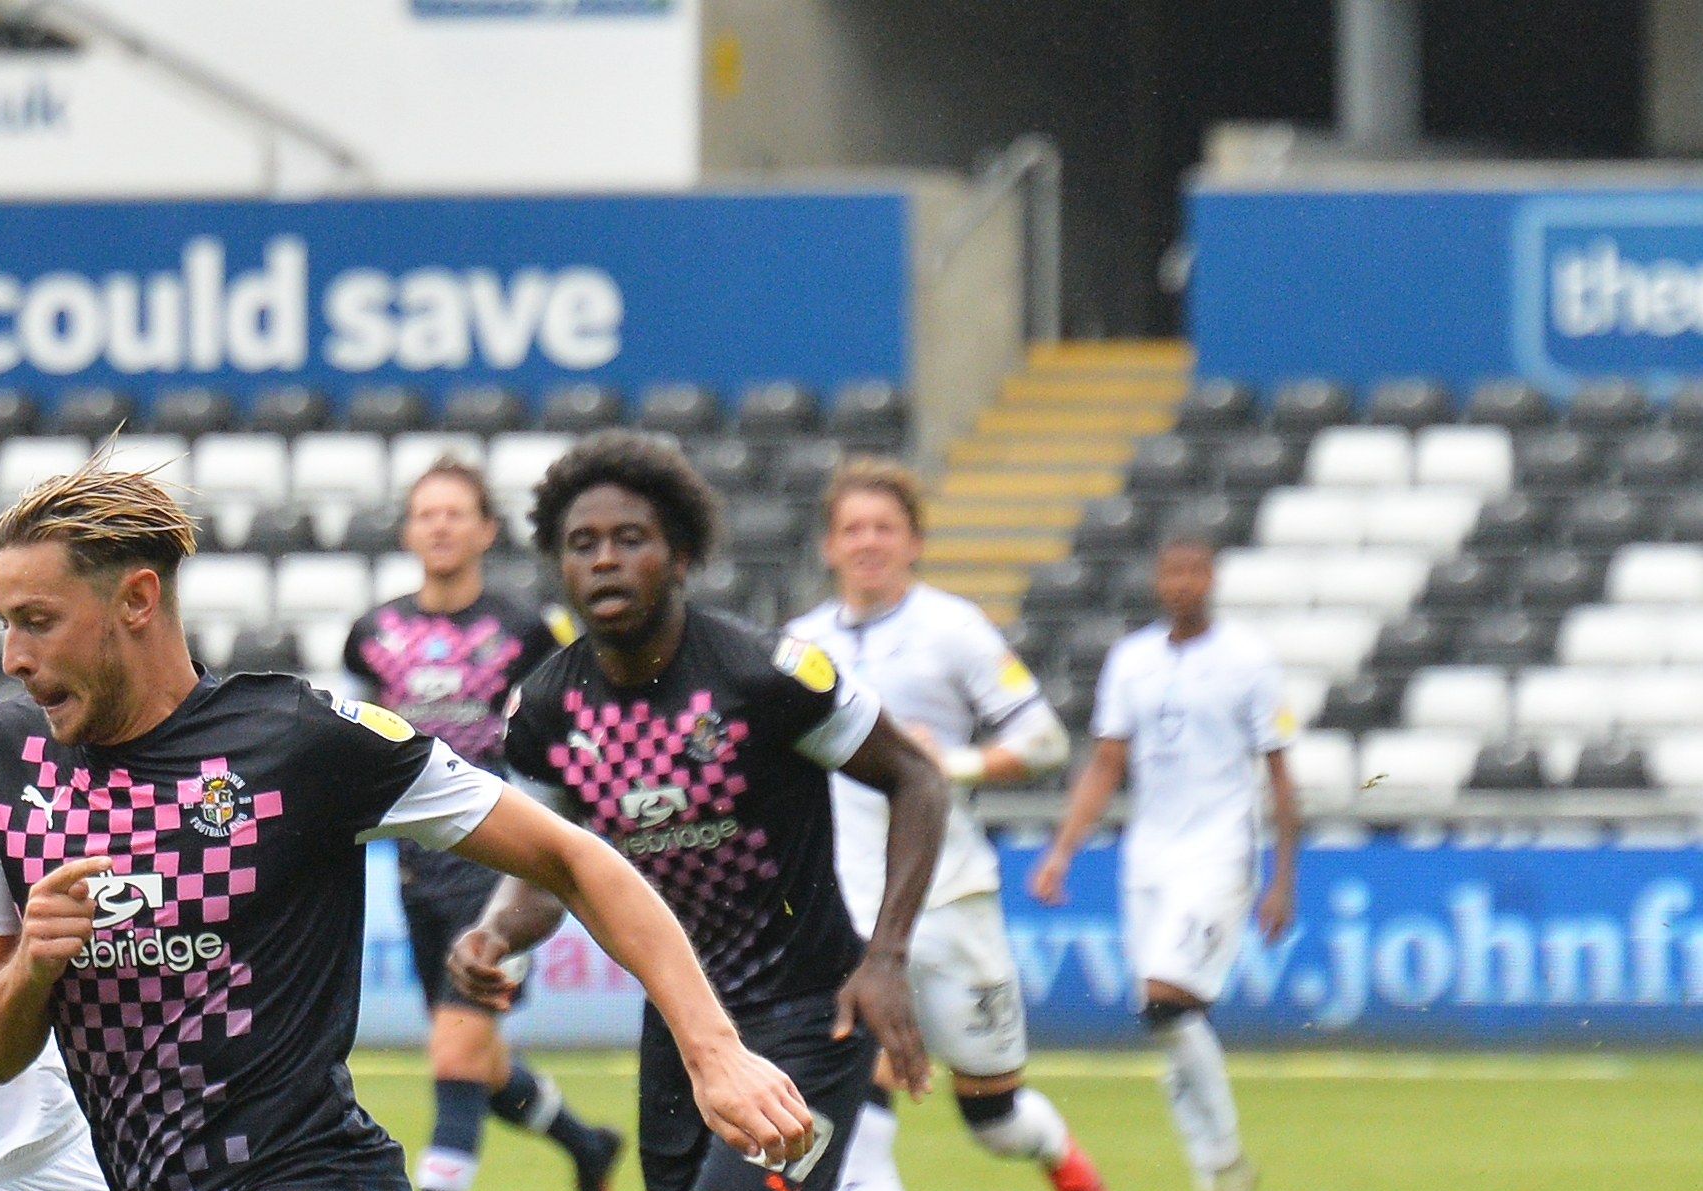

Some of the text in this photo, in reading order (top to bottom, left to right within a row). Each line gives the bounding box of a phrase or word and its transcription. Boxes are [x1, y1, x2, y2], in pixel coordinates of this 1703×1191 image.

[1550, 236, 1703, 337] the
[322, 266, 625, 372] save
[188, 771, 246, 793] LUTON TOWN
[190, 812, 248, 838] FOOTBALL CLUB
[70, 928, 223, 972] ebridge
